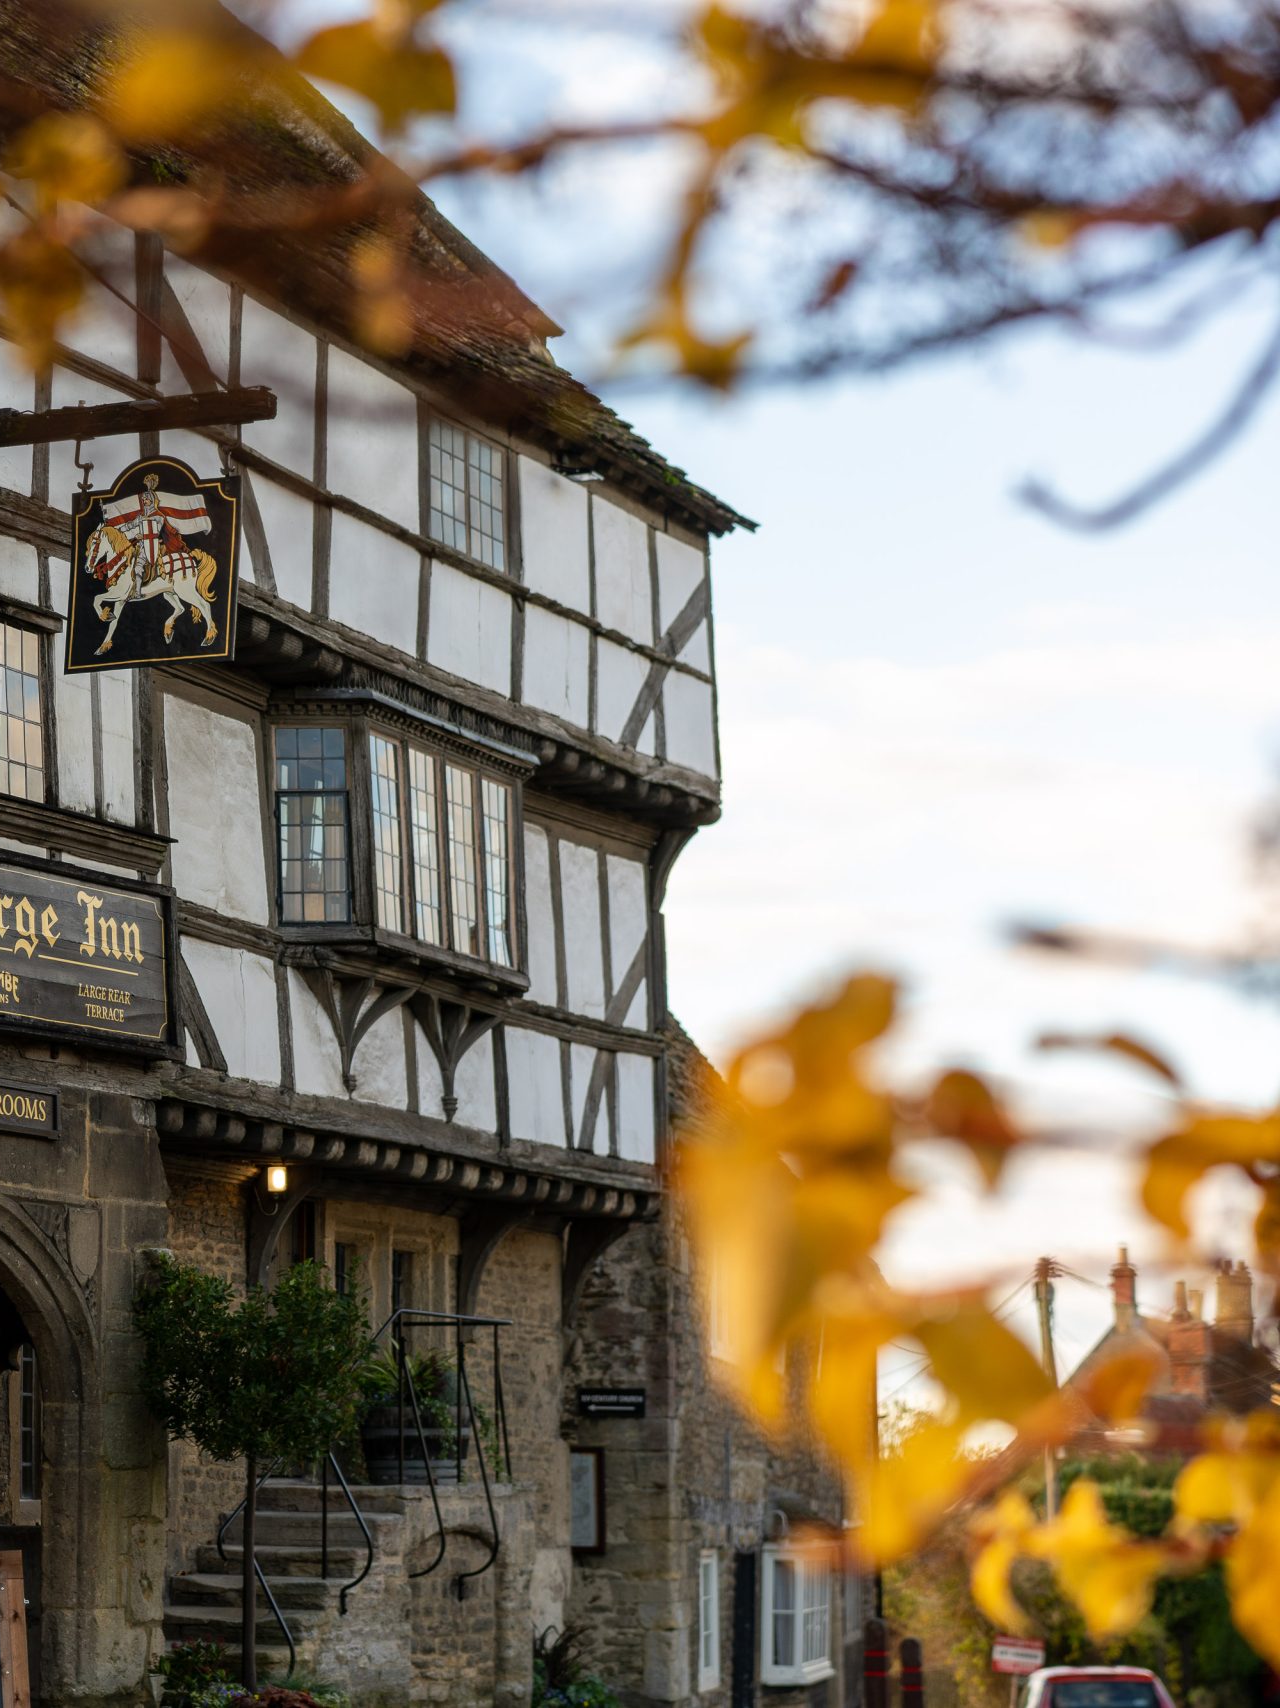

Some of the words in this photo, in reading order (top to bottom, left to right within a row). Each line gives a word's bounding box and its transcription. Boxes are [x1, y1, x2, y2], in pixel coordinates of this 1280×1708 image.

[77, 890, 145, 964] Inn
[78, 983, 107, 1001] LARGE
[108, 988, 131, 1005] REAR
[85, 1003, 125, 1023] TERRACE
